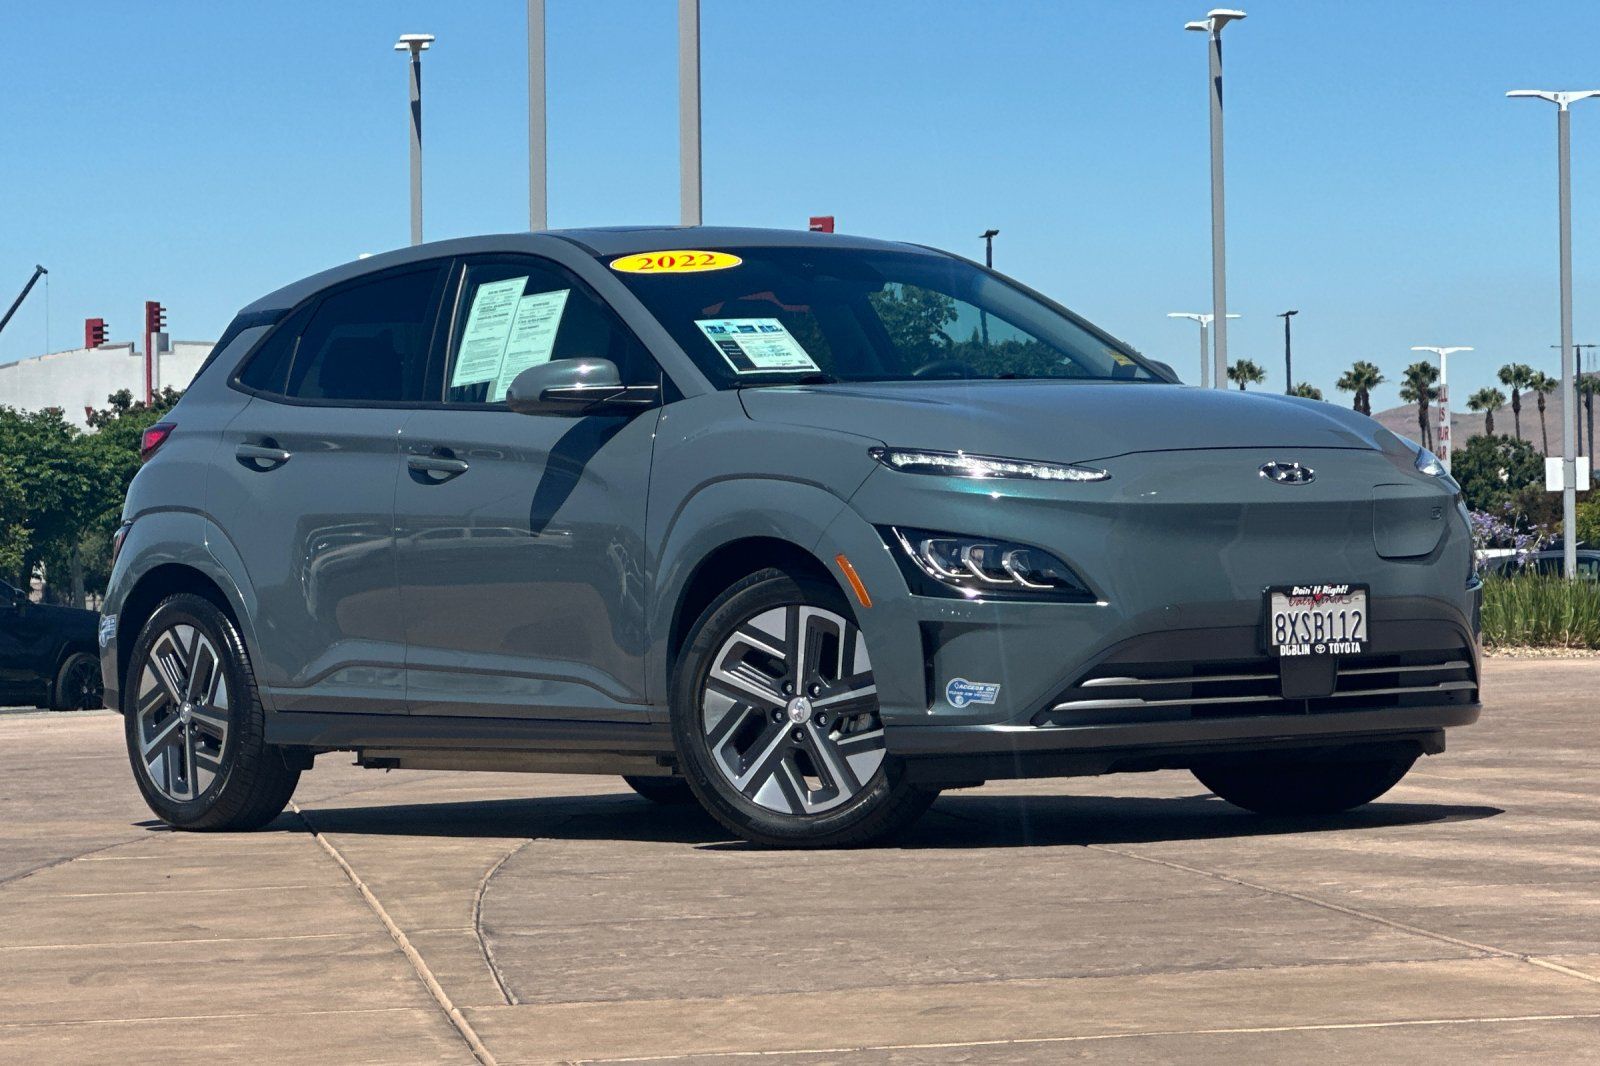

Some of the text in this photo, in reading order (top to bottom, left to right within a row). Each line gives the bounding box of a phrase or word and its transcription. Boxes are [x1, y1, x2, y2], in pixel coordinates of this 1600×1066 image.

[638, 254, 717, 270] 2022
[1292, 585, 1348, 596] Doin' It Right!
[1275, 611, 1362, 644] 8XSB112
[1280, 642, 1360, 655] DUBLIN TOYOTA
